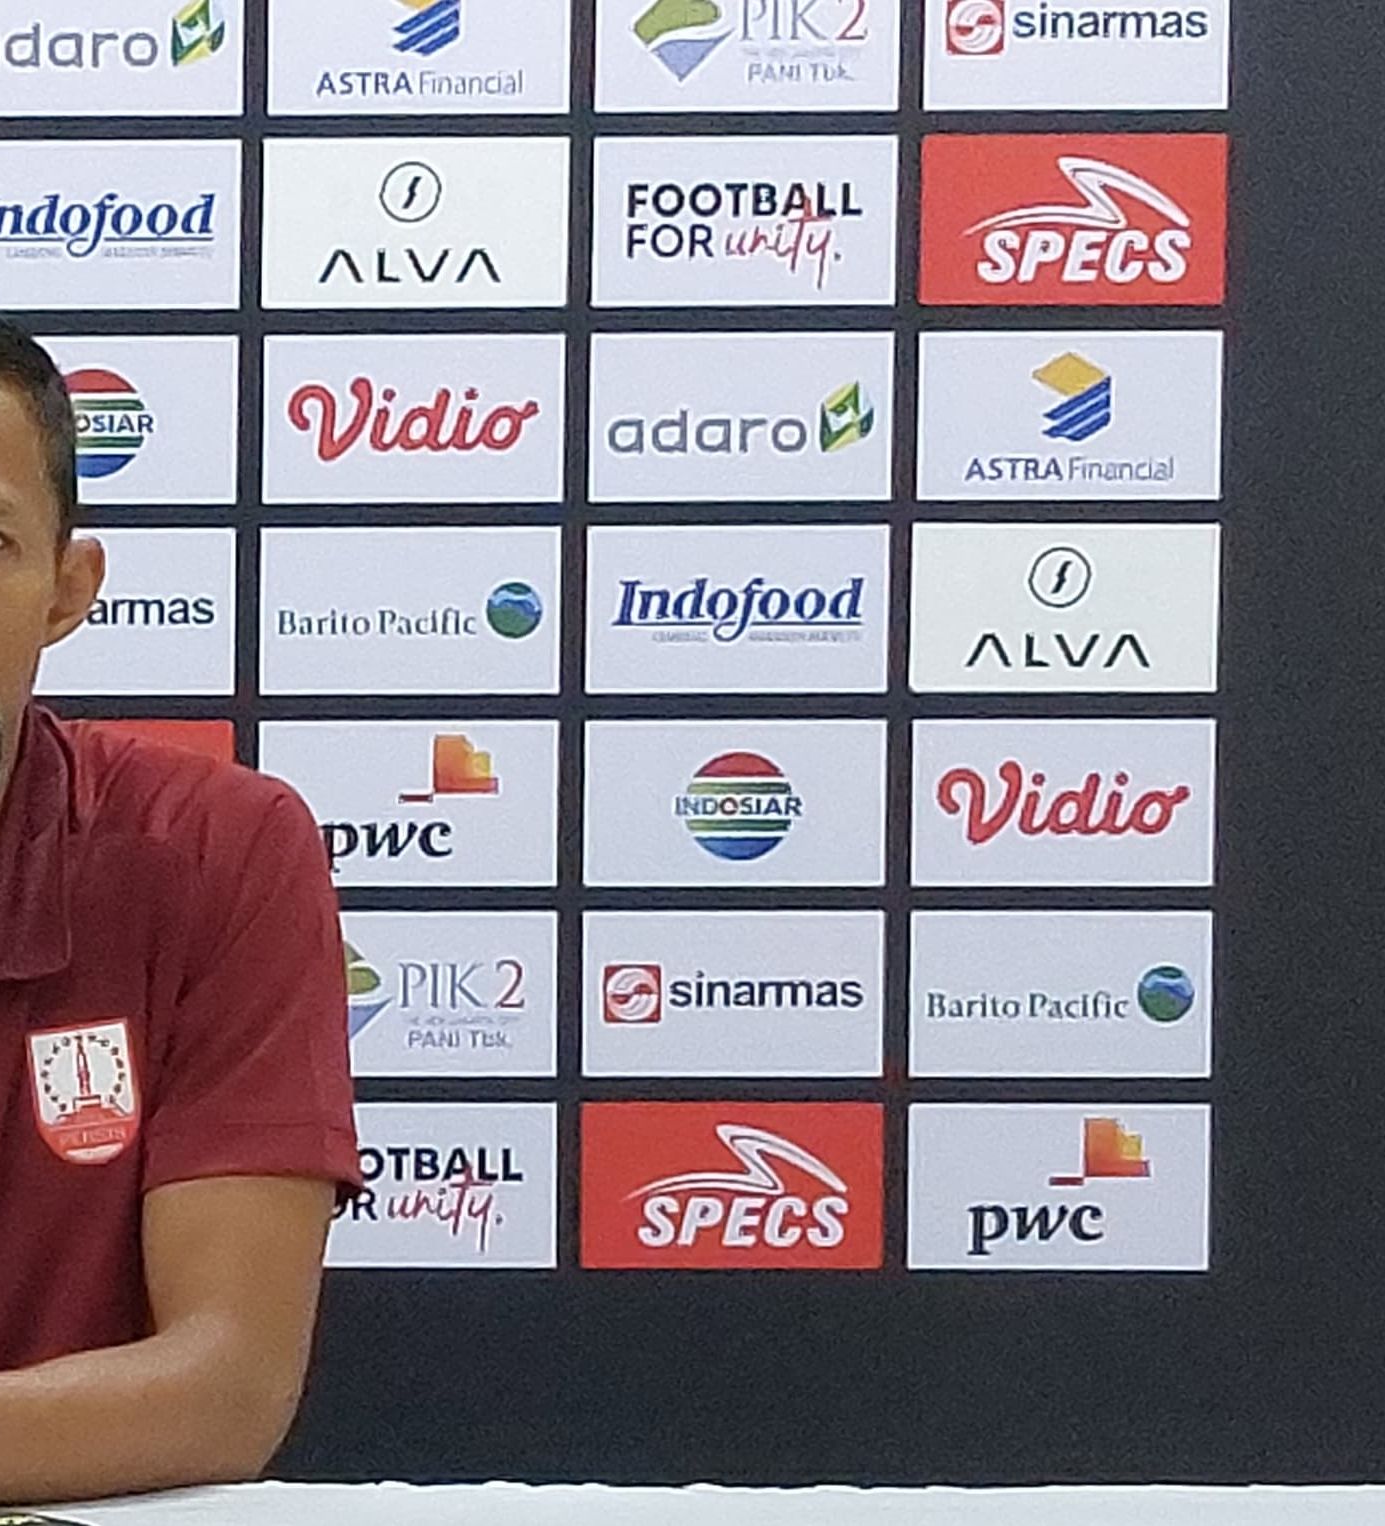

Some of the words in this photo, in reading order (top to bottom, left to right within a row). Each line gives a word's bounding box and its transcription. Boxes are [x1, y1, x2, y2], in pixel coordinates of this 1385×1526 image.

[739, 0, 828, 42] PIK
[836, 0, 868, 40] 2
[1012, 2, 1208, 39] sinarmas
[316, 72, 413, 97] ASTRA
[419, 69, 523, 96] Financial
[627, 183, 863, 218] FOOTBALL
[627, 223, 714, 259] FOR
[977, 230, 1191, 283] SPECS
[318, 248, 501, 283] ALVA
[75, 412, 155, 434] OSIAR
[288, 377, 539, 462] Vidio
[608, 409, 807, 454] adaro
[965, 457, 1063, 481] ASTRA
[1069, 456, 1174, 481] Financial
[86, 597, 215, 625] armas
[278, 608, 370, 636] Barito
[378, 607, 477, 635] Pacific
[611, 577, 864, 642] Indofood
[965, 632, 1150, 668] ALVA
[675, 794, 802, 817] INDOSIAR
[936, 761, 1190, 845] Vidio
[318, 821, 453, 873] pwc
[398, 963, 487, 1010] PIK
[494, 960, 525, 1008] 2
[669, 970, 863, 1008] sinarmas
[927, 992, 1021, 1019] Barito
[1029, 990, 1130, 1019] Pacific
[356, 1147, 524, 1181] OTBALL
[638, 1196, 848, 1247] SPECS
[967, 1205, 1104, 1256] pwc
